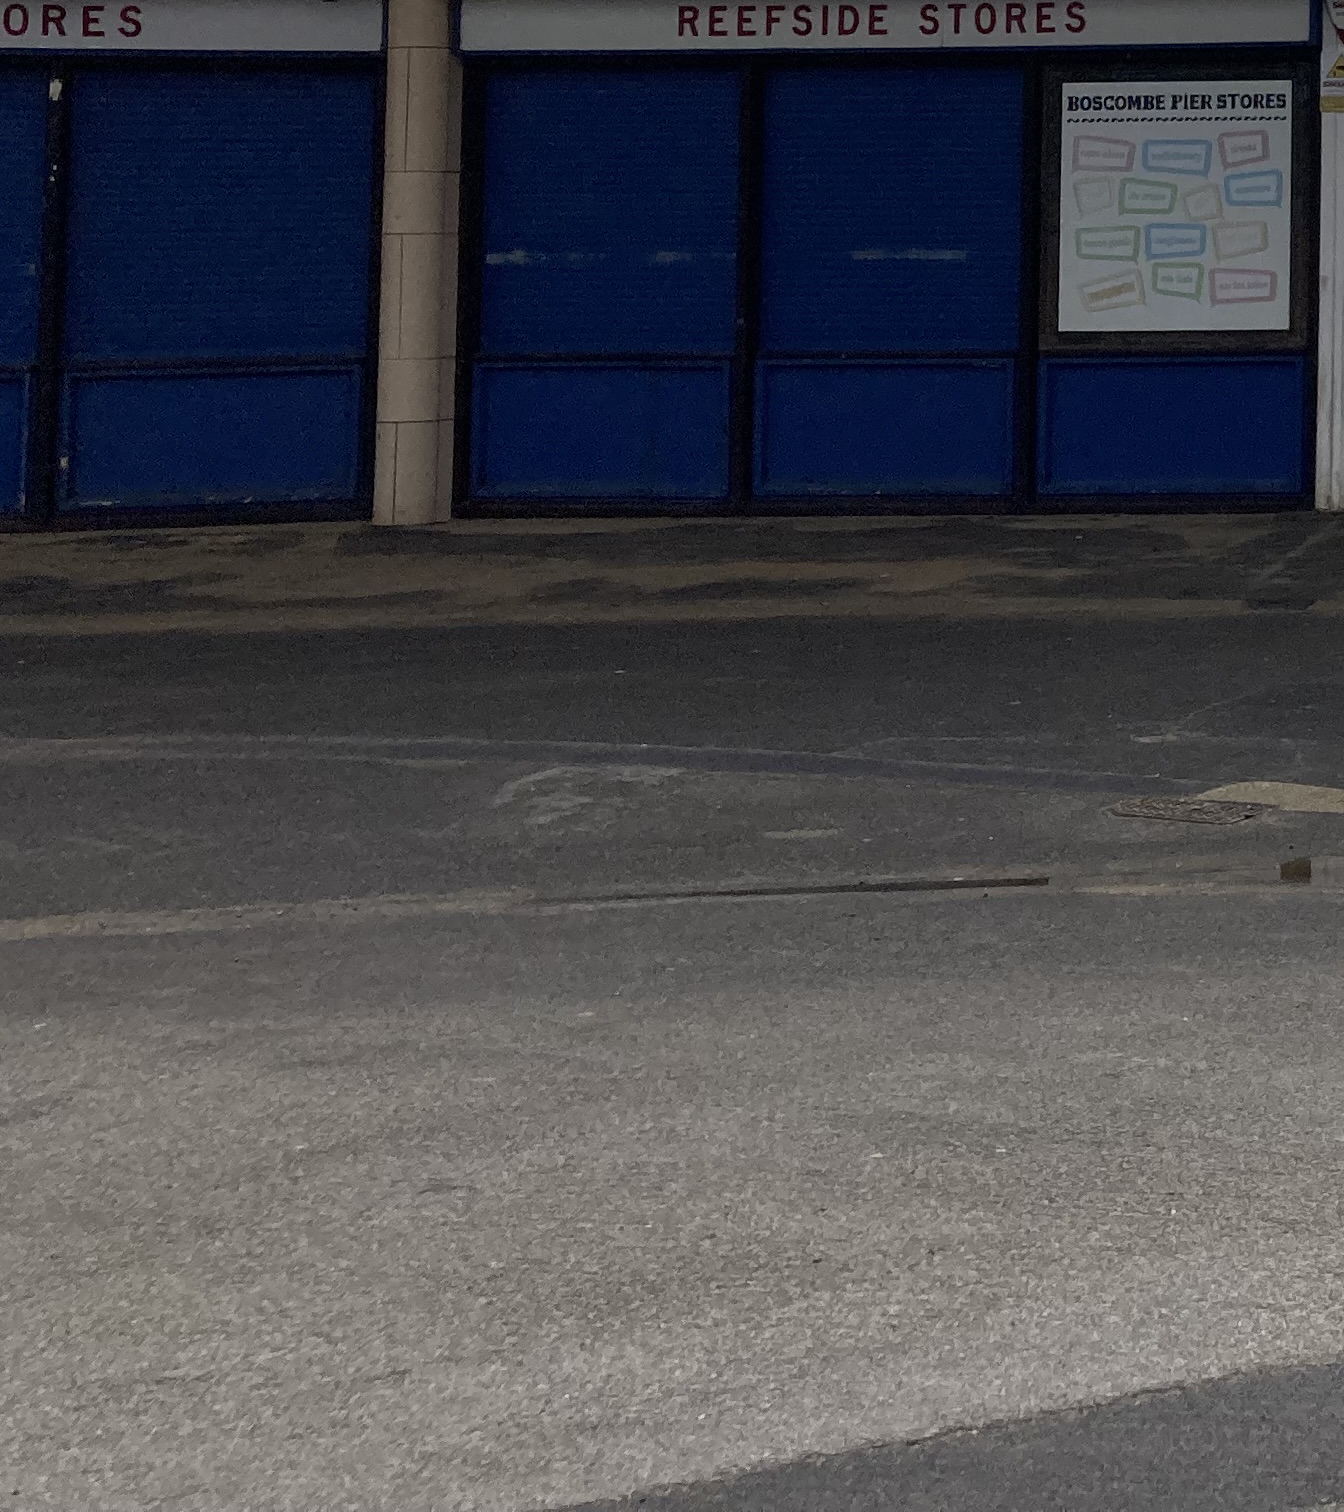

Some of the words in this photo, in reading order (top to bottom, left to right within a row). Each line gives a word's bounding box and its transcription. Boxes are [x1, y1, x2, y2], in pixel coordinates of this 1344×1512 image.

[2, 3, 143, 38] ORES
[677, 4, 889, 38] REEFSIDE
[918, 1, 1088, 36] STORES
[1066, 95, 1166, 111] BOSCOMBE
[1170, 93, 1213, 110] PIER
[1216, 93, 1287, 109] STORES
